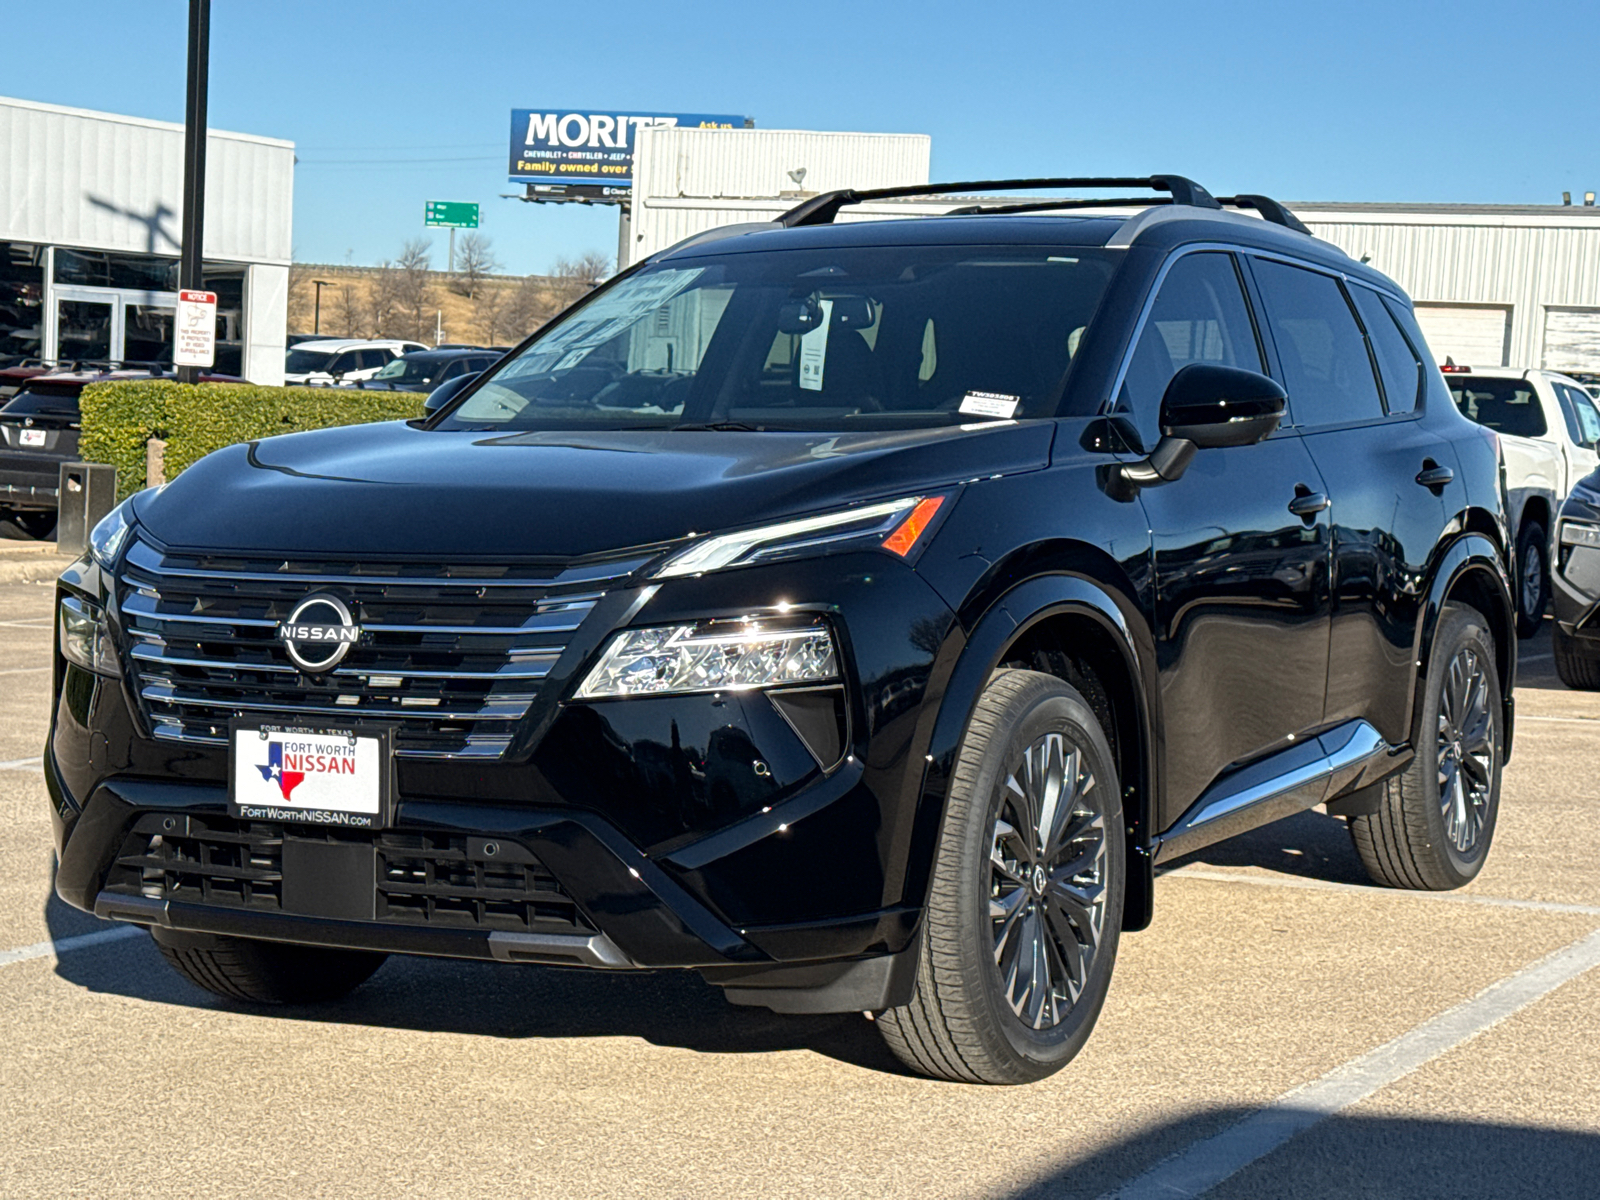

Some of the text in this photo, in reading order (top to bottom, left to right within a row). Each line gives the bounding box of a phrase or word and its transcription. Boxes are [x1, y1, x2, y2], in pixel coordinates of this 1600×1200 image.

[699, 121, 718, 129] Ask
[523, 150, 562, 159] CHEVROLET
[568, 151, 603, 160] CHRYSLER
[608, 153, 626, 161] JEEP
[517, 160, 556, 174] Family
[559, 163, 598, 173] owned
[601, 165, 628, 173] over
[187, 293, 207, 301] NOTICE
[280, 625, 355, 640] NISSAN
[260, 724, 353, 737] FORT WORTH TEXAS
[284, 742, 356, 756] FORT WORTH
[284, 753, 355, 775] NISSAN
